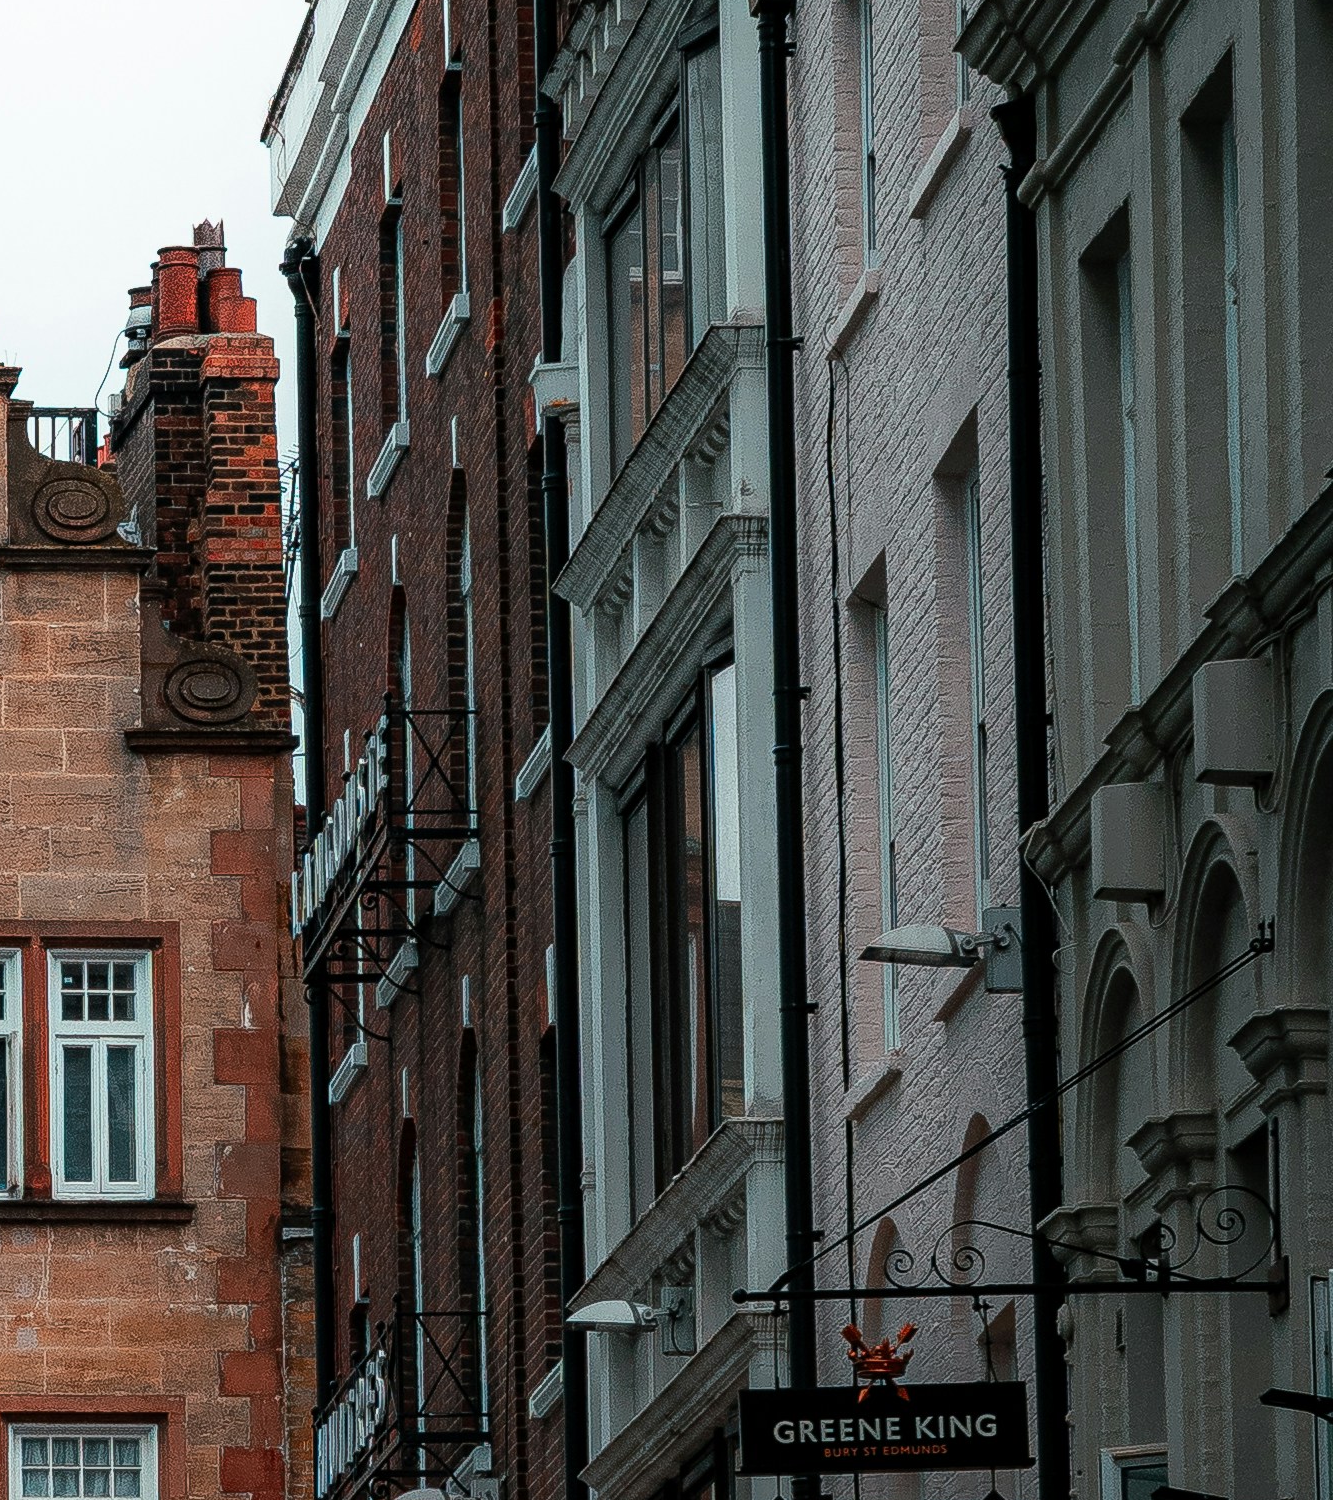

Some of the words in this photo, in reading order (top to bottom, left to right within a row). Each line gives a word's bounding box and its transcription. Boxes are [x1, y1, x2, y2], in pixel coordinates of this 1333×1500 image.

[773, 1417, 902, 1444] GREENE
[915, 1413, 997, 1440] KING
[823, 1445, 860, 1458] BURY
[863, 1444, 879, 1457] ST
[882, 1443, 948, 1457] EDMUNDS
